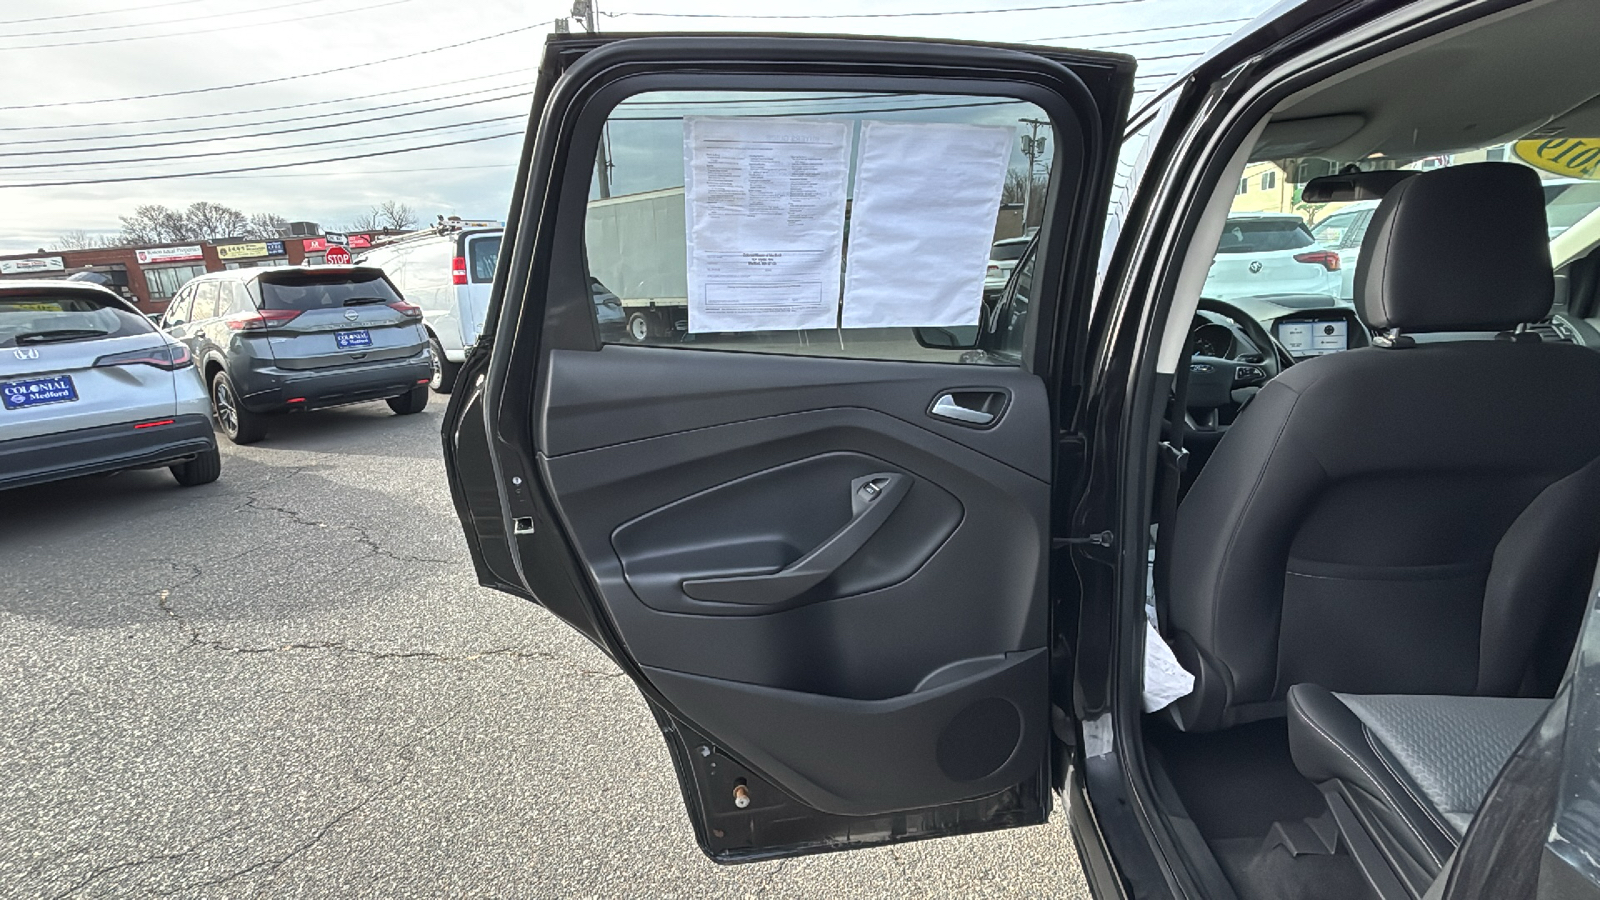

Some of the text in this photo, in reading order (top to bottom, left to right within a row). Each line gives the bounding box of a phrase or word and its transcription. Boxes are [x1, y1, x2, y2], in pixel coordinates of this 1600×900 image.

[327, 254, 349, 264] STOP
[337, 332, 369, 341] COLONIAL
[4, 381, 69, 396] COLONIAL
[29, 389, 69, 400] Medford
